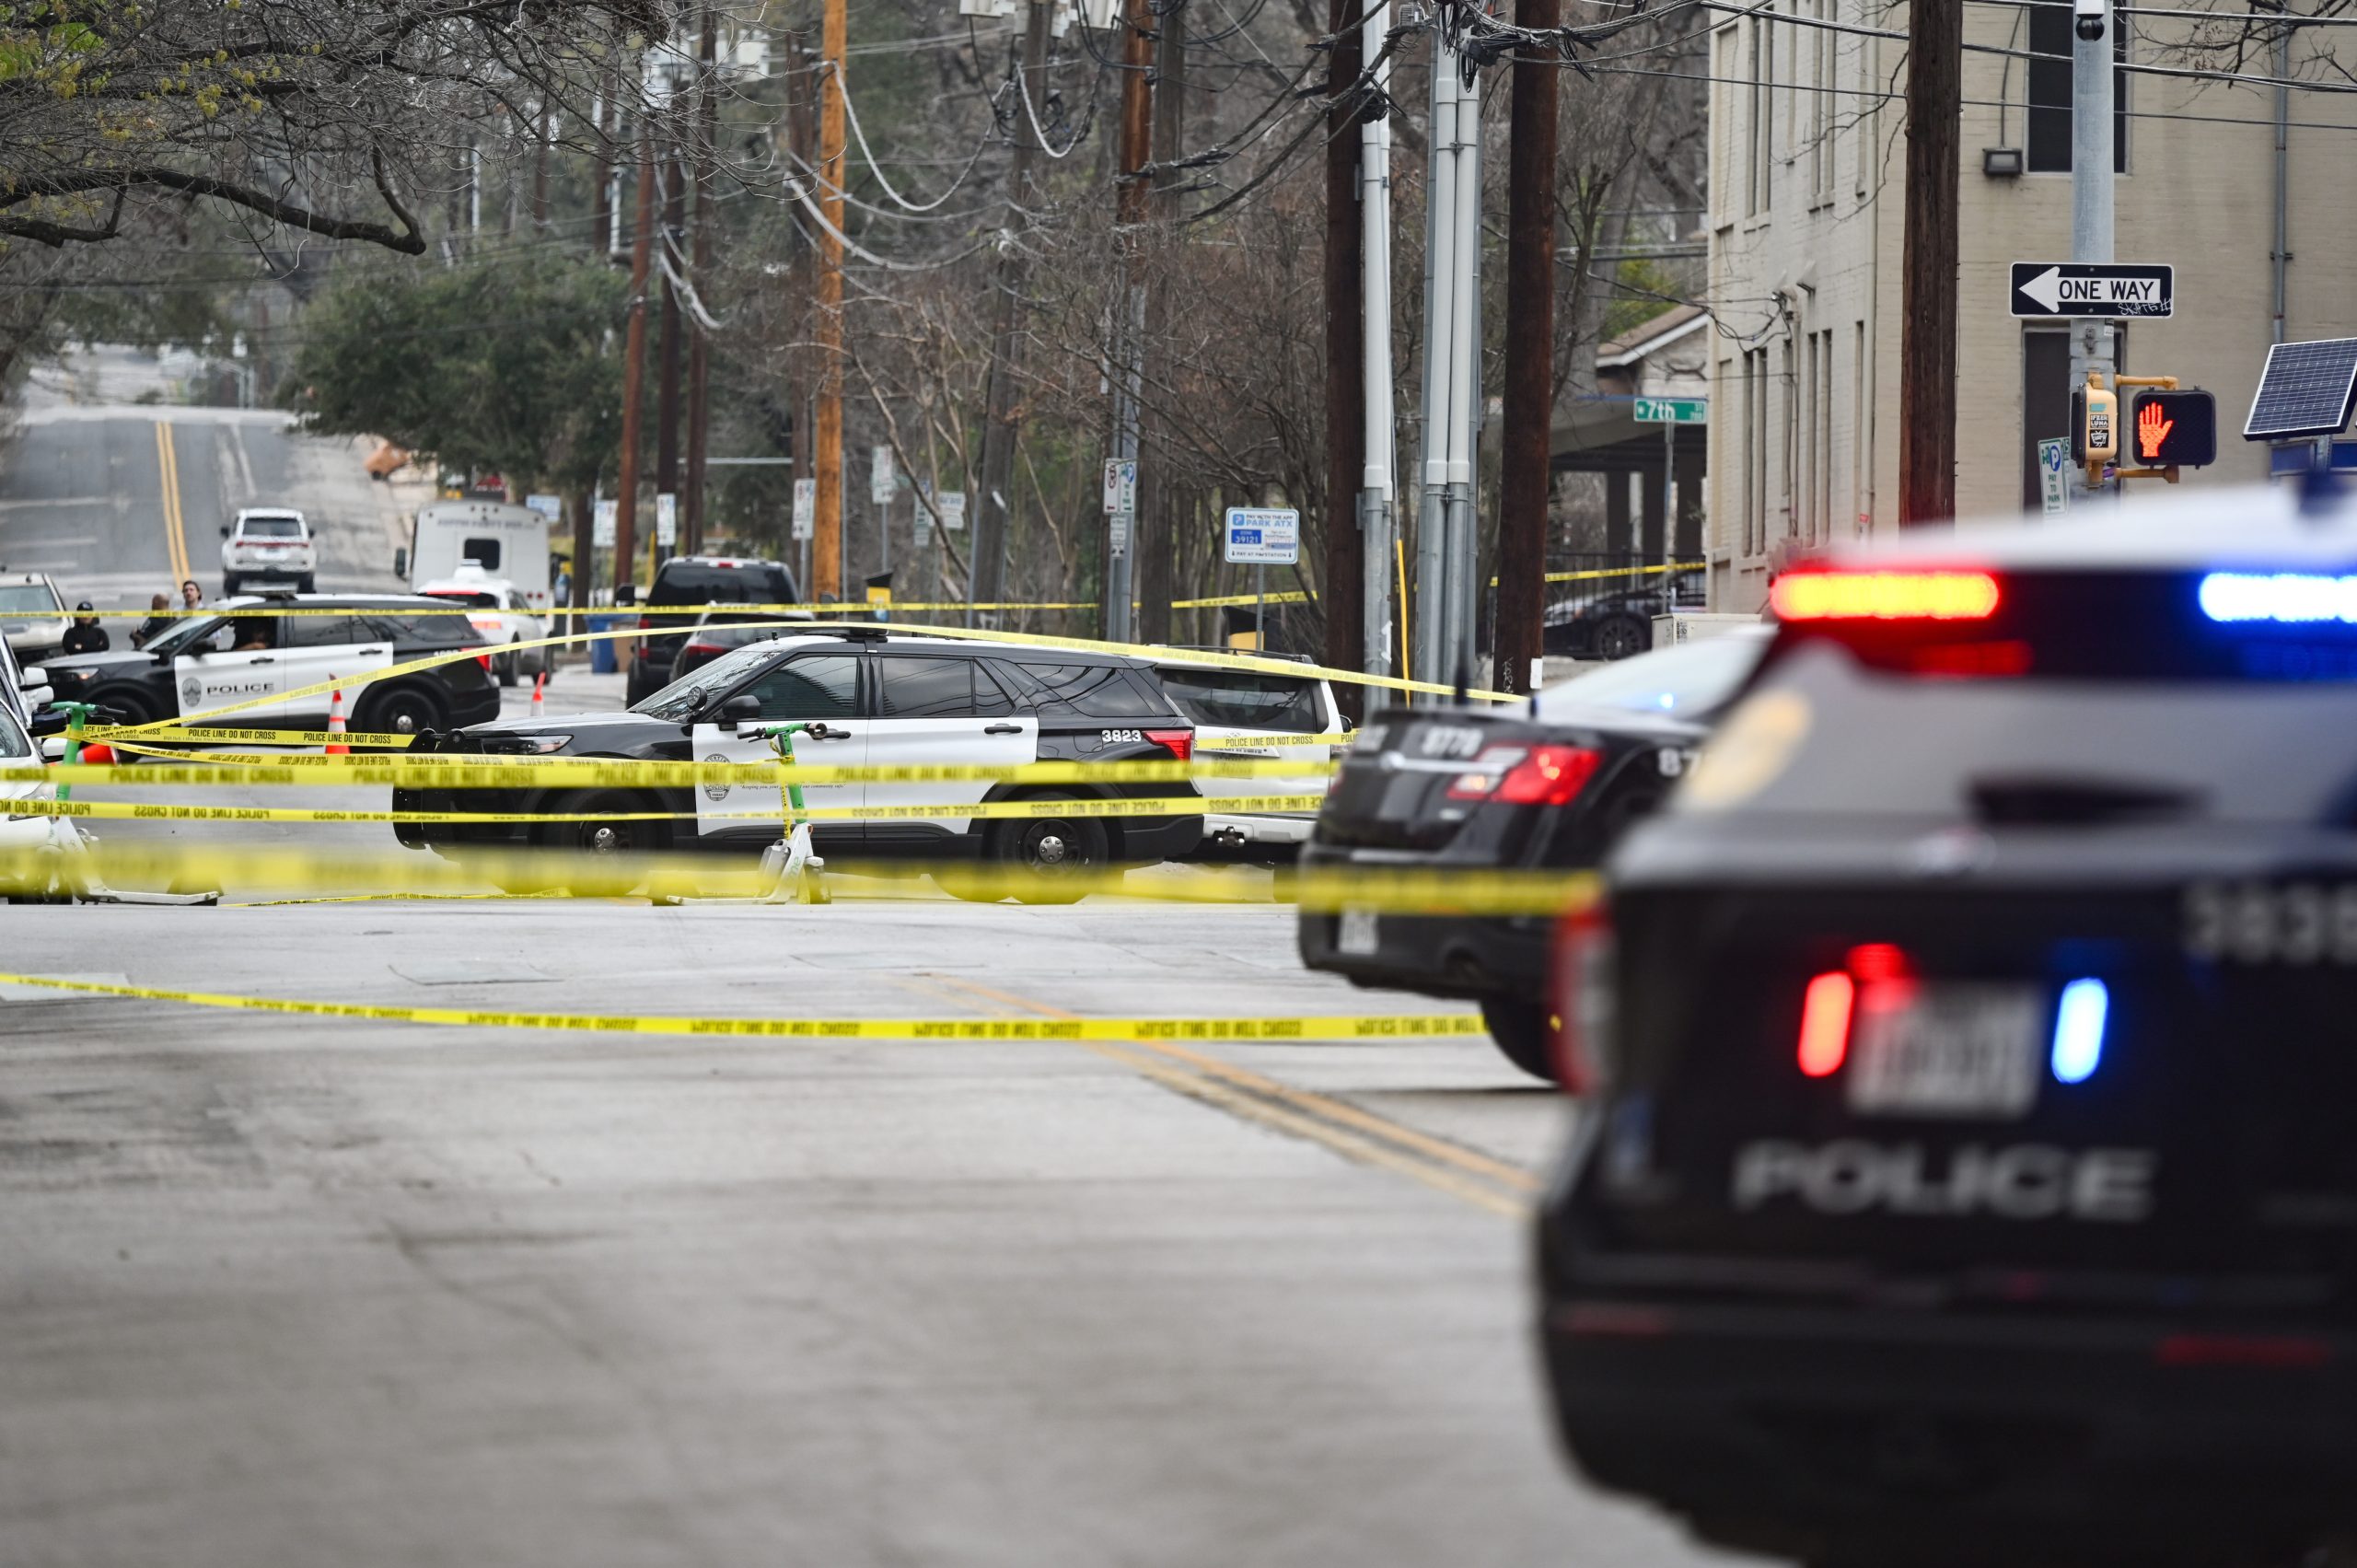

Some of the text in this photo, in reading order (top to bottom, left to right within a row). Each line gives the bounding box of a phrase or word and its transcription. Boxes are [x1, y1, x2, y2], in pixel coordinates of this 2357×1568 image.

[2059, 280, 2154, 300] ONE WAY
[1646, 401, 1675, 420] 7th
[2047, 494, 2060, 503] PARK
[207, 683, 274, 695] POLICE
[188, 729, 276, 740] POLICE LINE DO NOT CROSS
[303, 733, 391, 743] POLICE LINE DO NOT CROSS
[1102, 730, 1141, 742] 3823
[1341, 734, 1355, 743] POLI
[1225, 736, 1313, 747] POLICE LINE DO NOT CROSS
[1031, 802, 1165, 815] POLICE LINE DO NOT CROSS
[1209, 798, 1306, 811] LINE DO NOT CROSS
[852, 806, 987, 818] POLICE LINE DO NOT CROSS
[1732, 1139, 2155, 1221] POLICE
